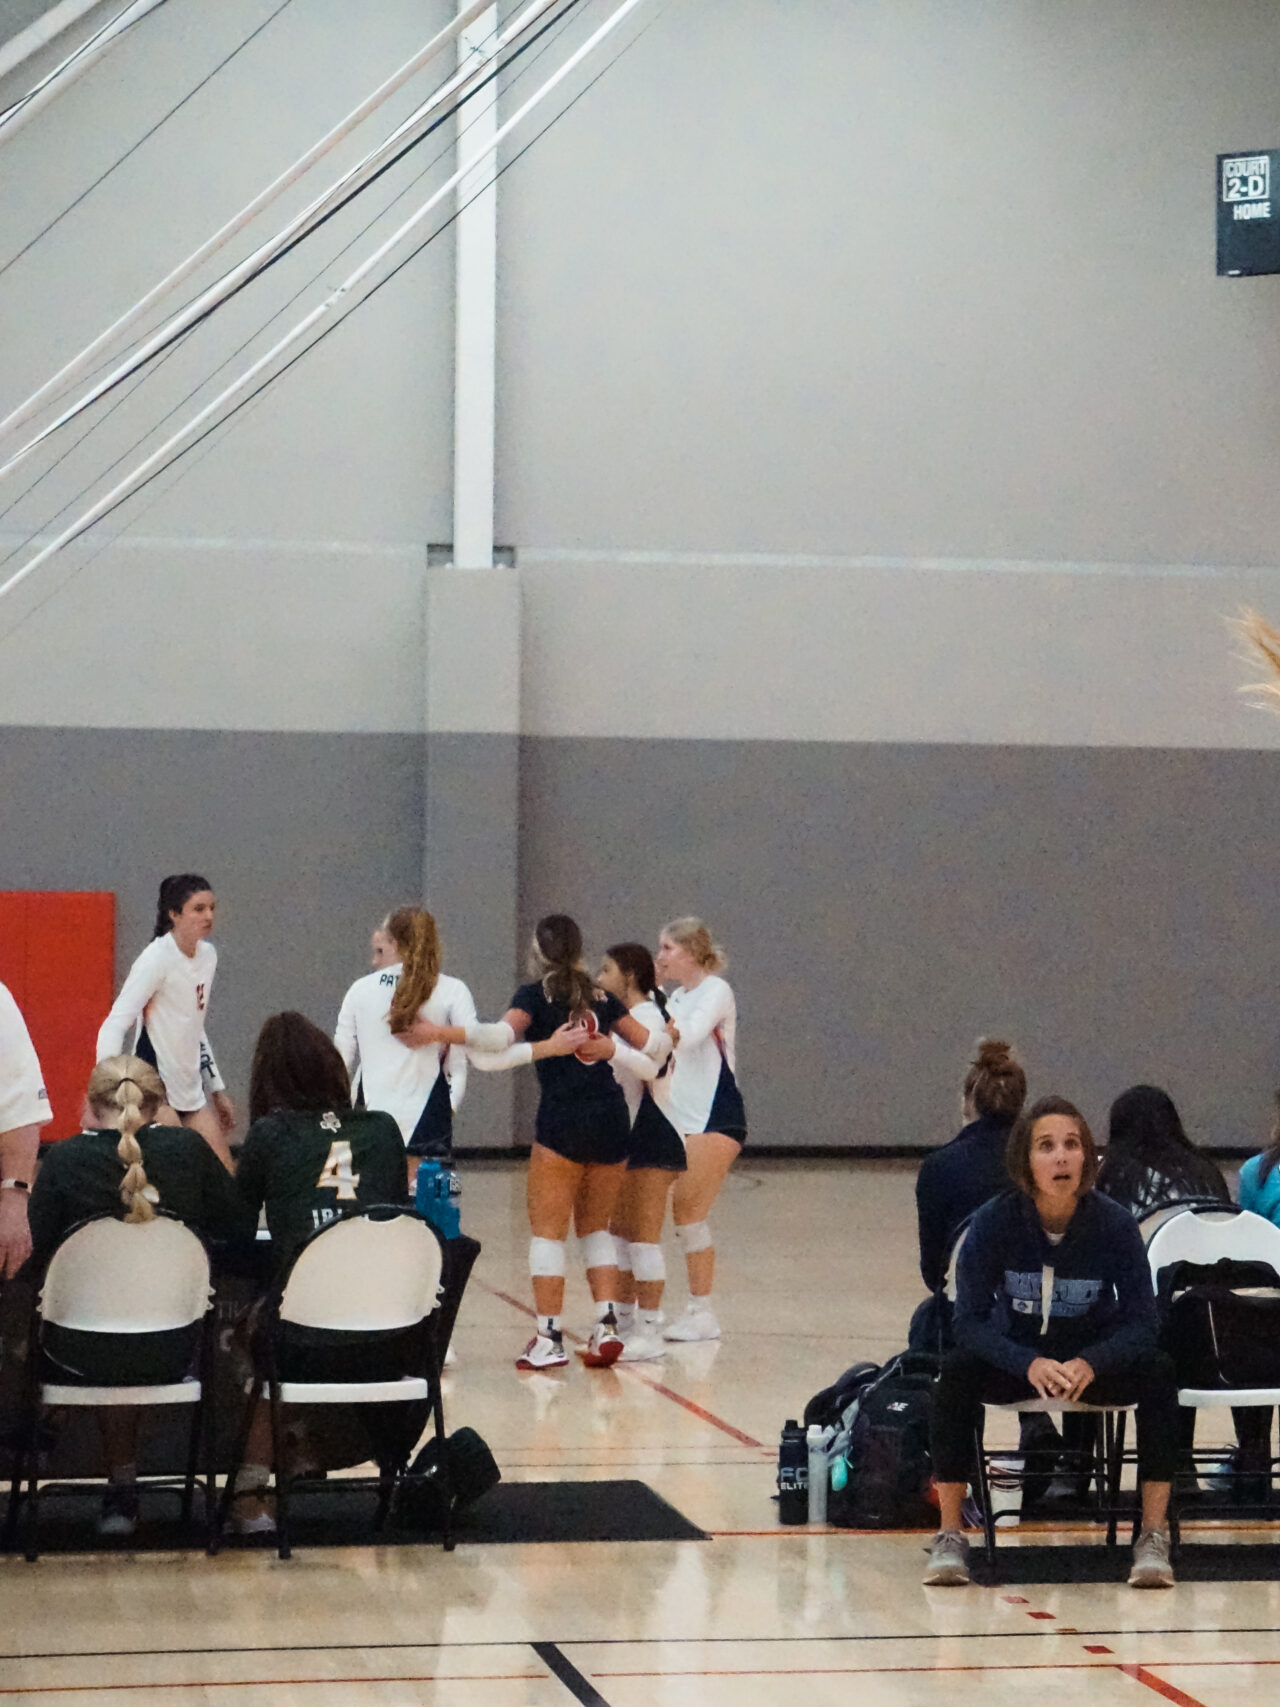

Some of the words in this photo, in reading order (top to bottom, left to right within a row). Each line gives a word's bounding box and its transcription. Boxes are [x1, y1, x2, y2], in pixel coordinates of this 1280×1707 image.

[1225, 159, 1267, 177] COURT
[1228, 175, 1265, 198] 2-D
[1233, 202, 1271, 220] HOME
[316, 1140, 360, 1200] 4
